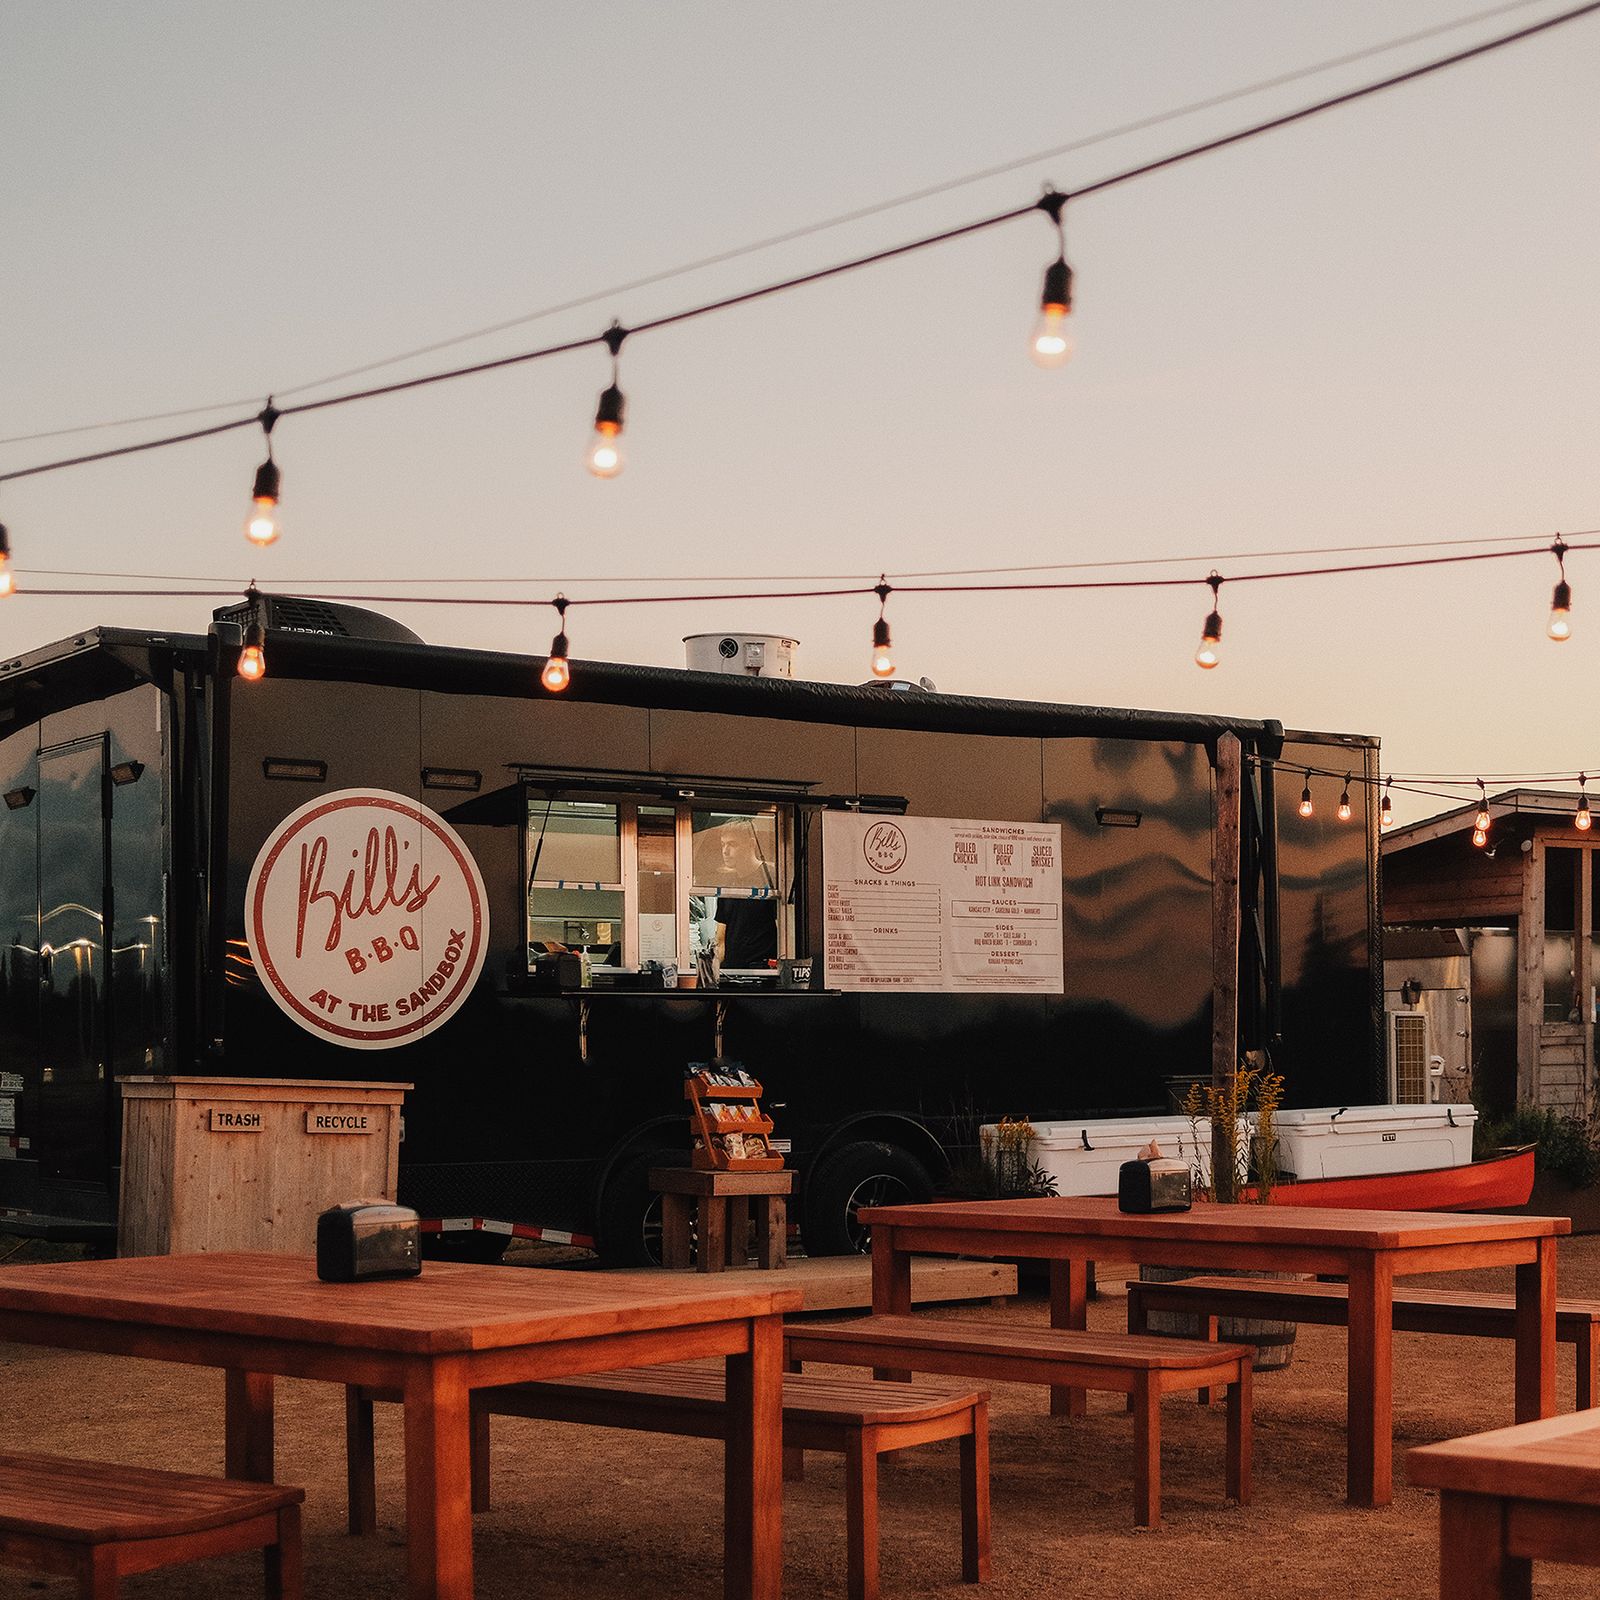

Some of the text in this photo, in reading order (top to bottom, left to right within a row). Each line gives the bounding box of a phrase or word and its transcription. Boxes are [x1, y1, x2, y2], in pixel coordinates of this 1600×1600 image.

[955, 842, 976, 853] PULLED
[993, 844, 1014, 854] PULLED
[1032, 846, 1052, 856] SLICED
[953, 853, 978, 864] CHICKEN
[996, 855, 1012, 866] PORK
[1031, 857, 1054, 868] BRISKET
[976, 876, 1034, 888] HOT LINK SANDWICH
[296, 825, 441, 959] Bill's
[309, 928, 466, 1022] AT THE SANDBOX
[792, 967, 812, 978] TIPS
[217, 1113, 260, 1126] TRASH
[316, 1116, 368, 1128] RECYCLE
